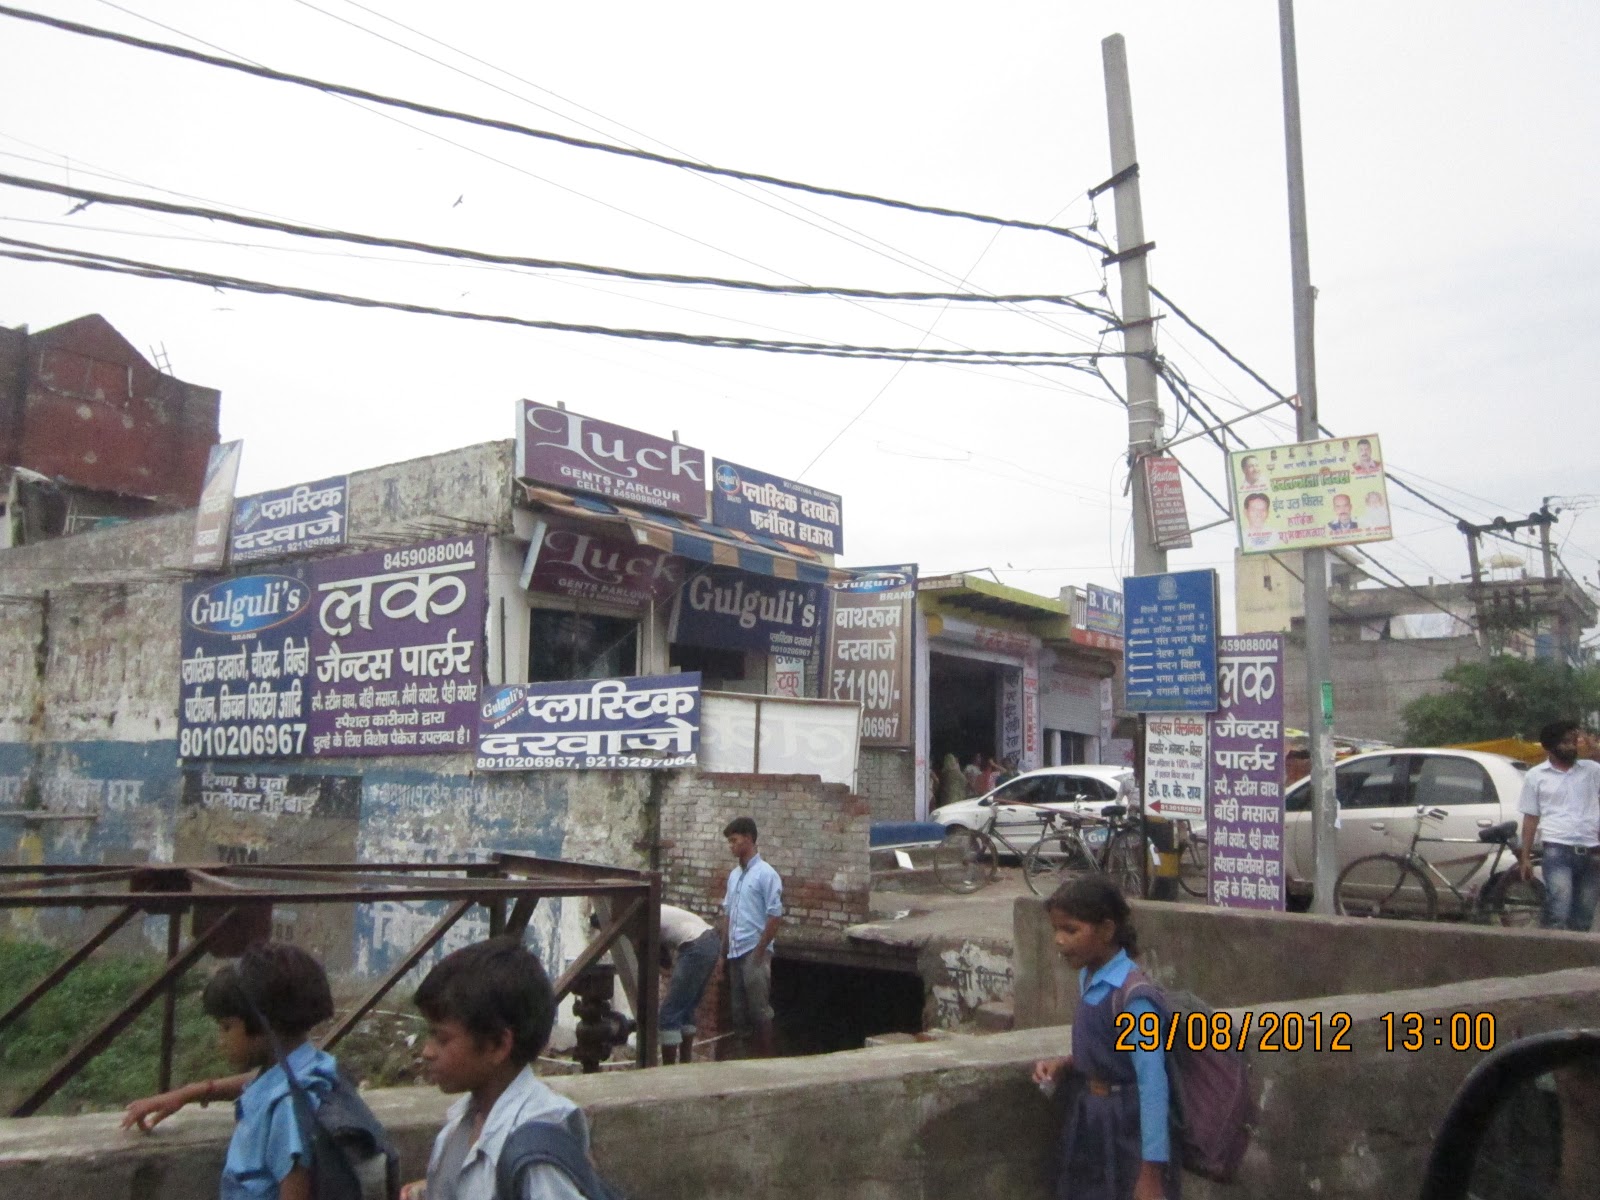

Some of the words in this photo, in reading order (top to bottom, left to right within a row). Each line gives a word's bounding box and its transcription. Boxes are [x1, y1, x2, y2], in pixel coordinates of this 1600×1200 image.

[527, 406, 703, 481] Luck
[560, 465, 611, 486] GENTS
[616, 478, 680, 502] PARLOUR
[577, 479, 601, 493] CELL
[261, 485, 344, 520] प्लास्टिक
[741, 481, 797, 513] प्लास्टिक
[800, 498, 840, 526] दरवाजे
[233, 510, 344, 550] दरवाजे
[750, 508, 796, 539] फर्नीचर
[383, 540, 474, 570] 8459088004
[544, 530, 679, 584] Luck
[191, 580, 301, 628] Gulguli's
[317, 561, 475, 636] लक
[689, 574, 816, 629] Gulguli's
[879, 590, 915, 601] BRAND
[835, 606, 902, 628] बाथरूम
[315, 641, 394, 683] जैन्टस
[399, 628, 474, 677] पार्लर
[837, 630, 898, 661] दरवाजे
[1170, 636, 1187, 645] नगर
[1178, 646, 1194, 657] गली
[1180, 659, 1201, 670] विहार
[278, 678, 303, 719] आदि
[482, 687, 524, 718] Gulguli's
[526, 680, 699, 723] प्लास्टिक
[493, 707, 525, 729] BRAND
[1215, 712, 1279, 739] जैन्टस
[180, 723, 307, 757] 8010206967
[333, 732, 342, 747] के
[344, 730, 362, 748] लिए
[363, 729, 389, 747] विशेष
[479, 717, 700, 756] दरवाजे
[476, 756, 580, 769] 8010206967,
[1215, 744, 1278, 771] पार्लर
[1241, 805, 1280, 823] मसाज
[1231, 876, 1240, 897] के
[1241, 876, 1257, 900] लिए
[1258, 878, 1280, 901] विशेष
